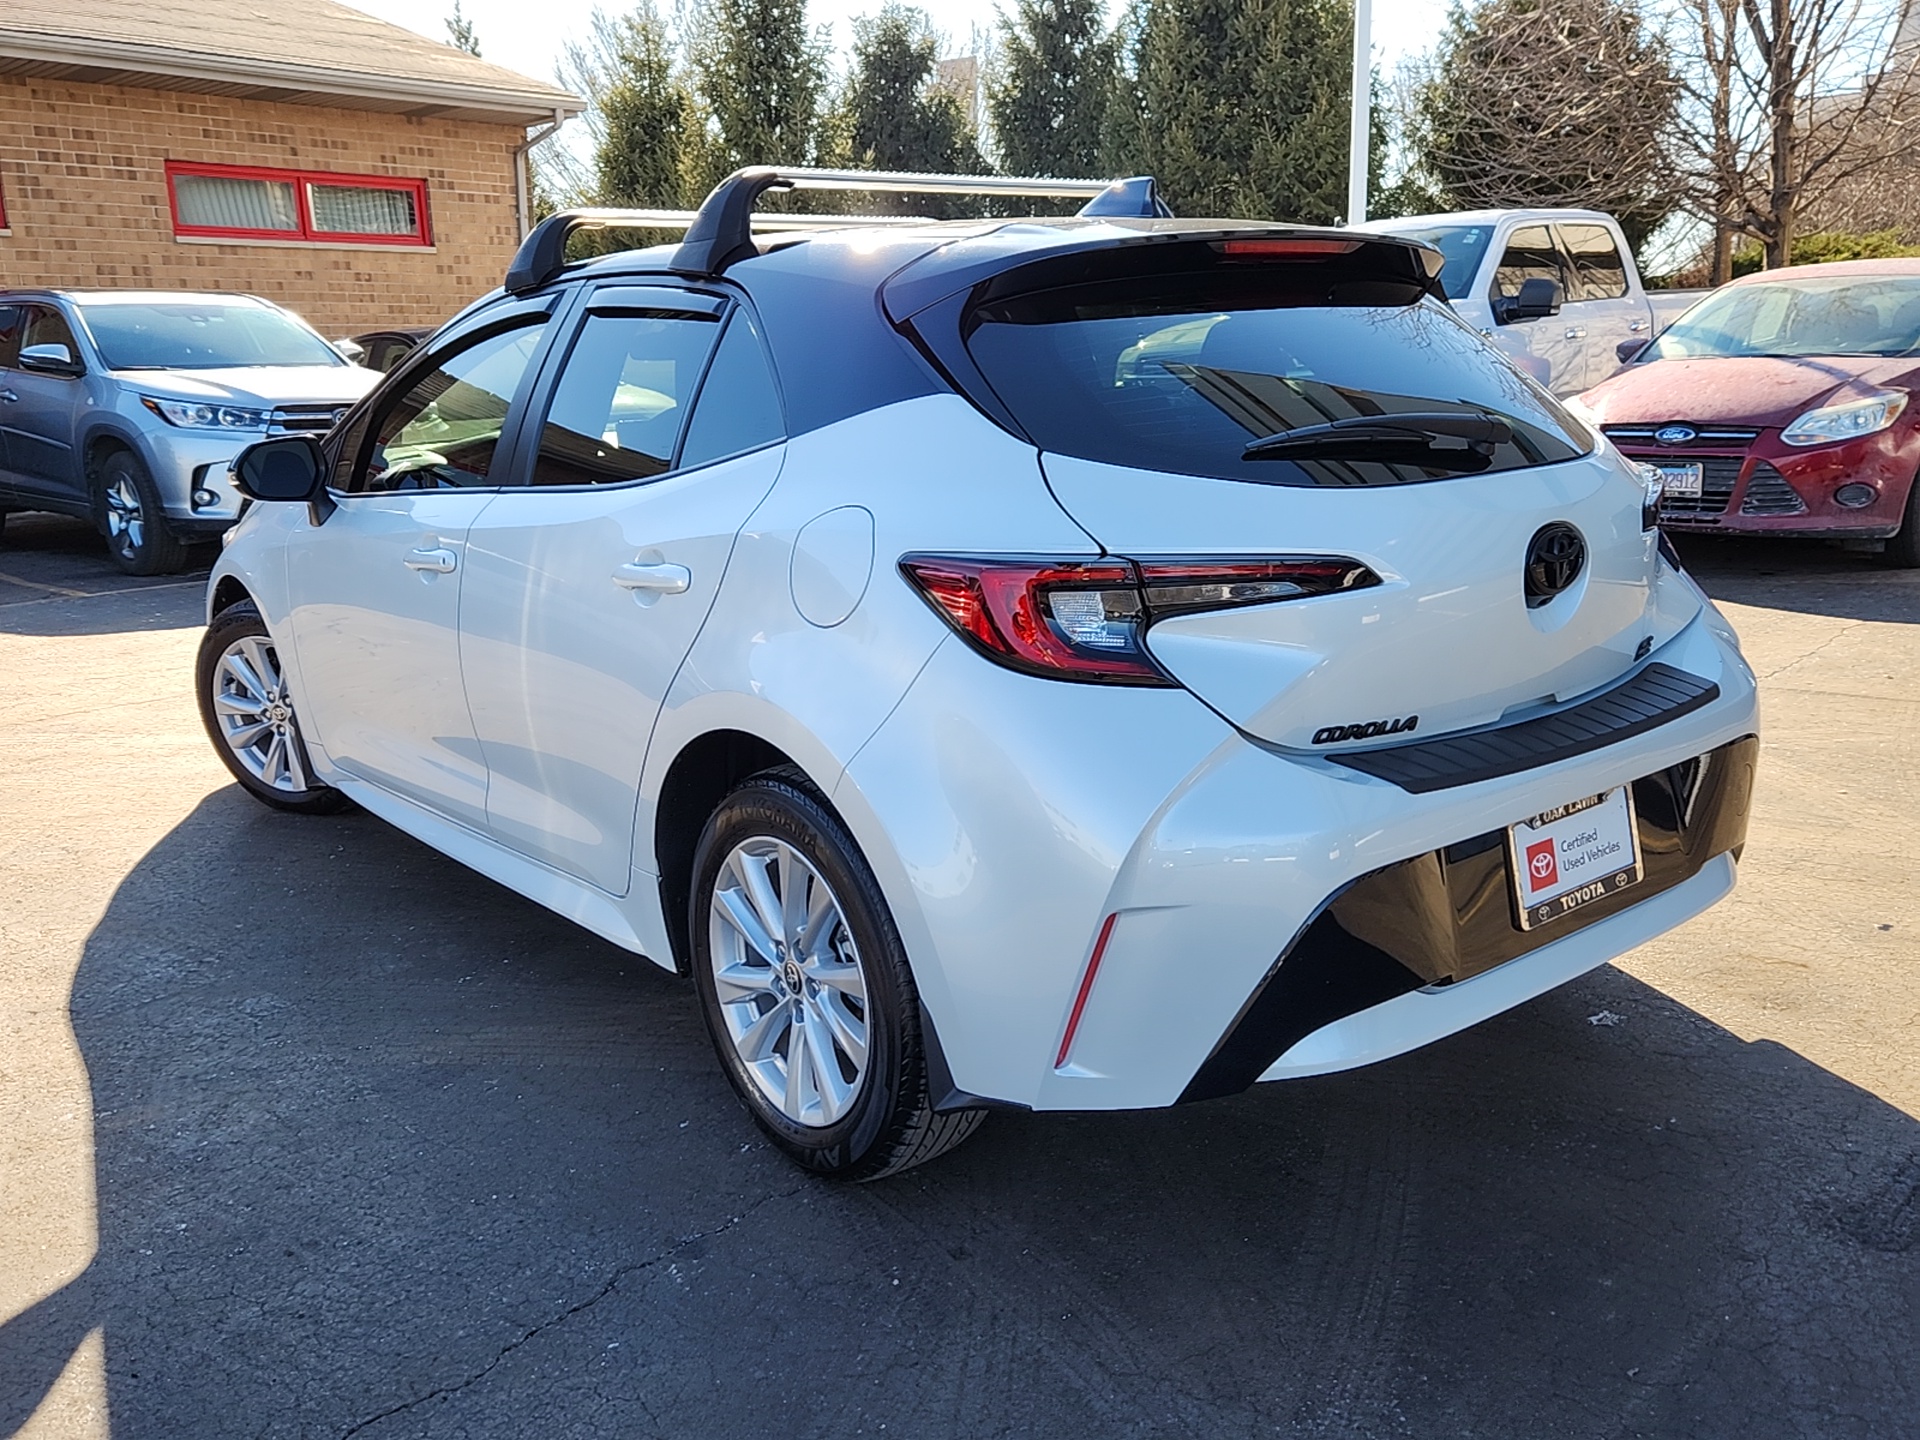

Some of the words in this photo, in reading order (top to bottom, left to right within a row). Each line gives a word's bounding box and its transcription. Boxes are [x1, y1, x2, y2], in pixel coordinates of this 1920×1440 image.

[1311, 715, 1419, 744] COROLLA
[1543, 806, 1566, 822] OAK
[1561, 828, 1598, 853] Certified
[1563, 854, 1586, 871] Used
[1587, 841, 1621, 862] Vehicles
[1559, 882, 1605, 910] TOYOTA
